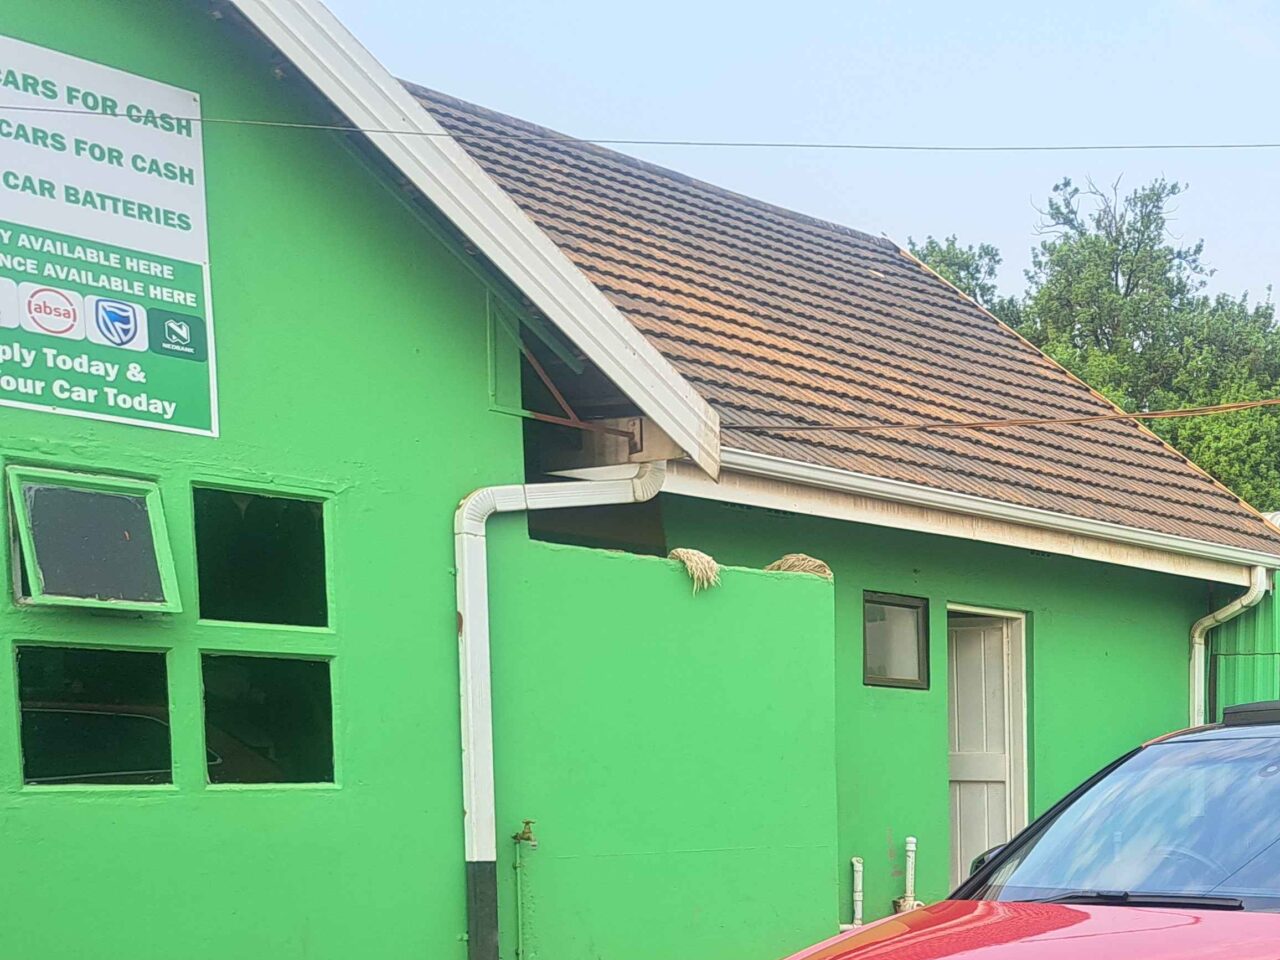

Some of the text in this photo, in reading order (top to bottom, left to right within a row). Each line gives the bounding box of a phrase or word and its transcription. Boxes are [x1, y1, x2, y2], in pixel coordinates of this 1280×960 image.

[0, 69, 193, 138] ARS FOR CASH
[0, 118, 195, 185] CARS FOR CASH
[3, 170, 192, 231] CAR BATTERIES
[17, 233, 121, 268] AVAILABLE
[125, 256, 175, 280] HERE
[43, 262, 145, 296] AVAILABLE
[149, 285, 197, 308] HERE
[33, 301, 71, 319] absa
[42, 347, 119, 381] Today
[126, 363, 146, 383] &
[0, 374, 177, 419] our Car Today
